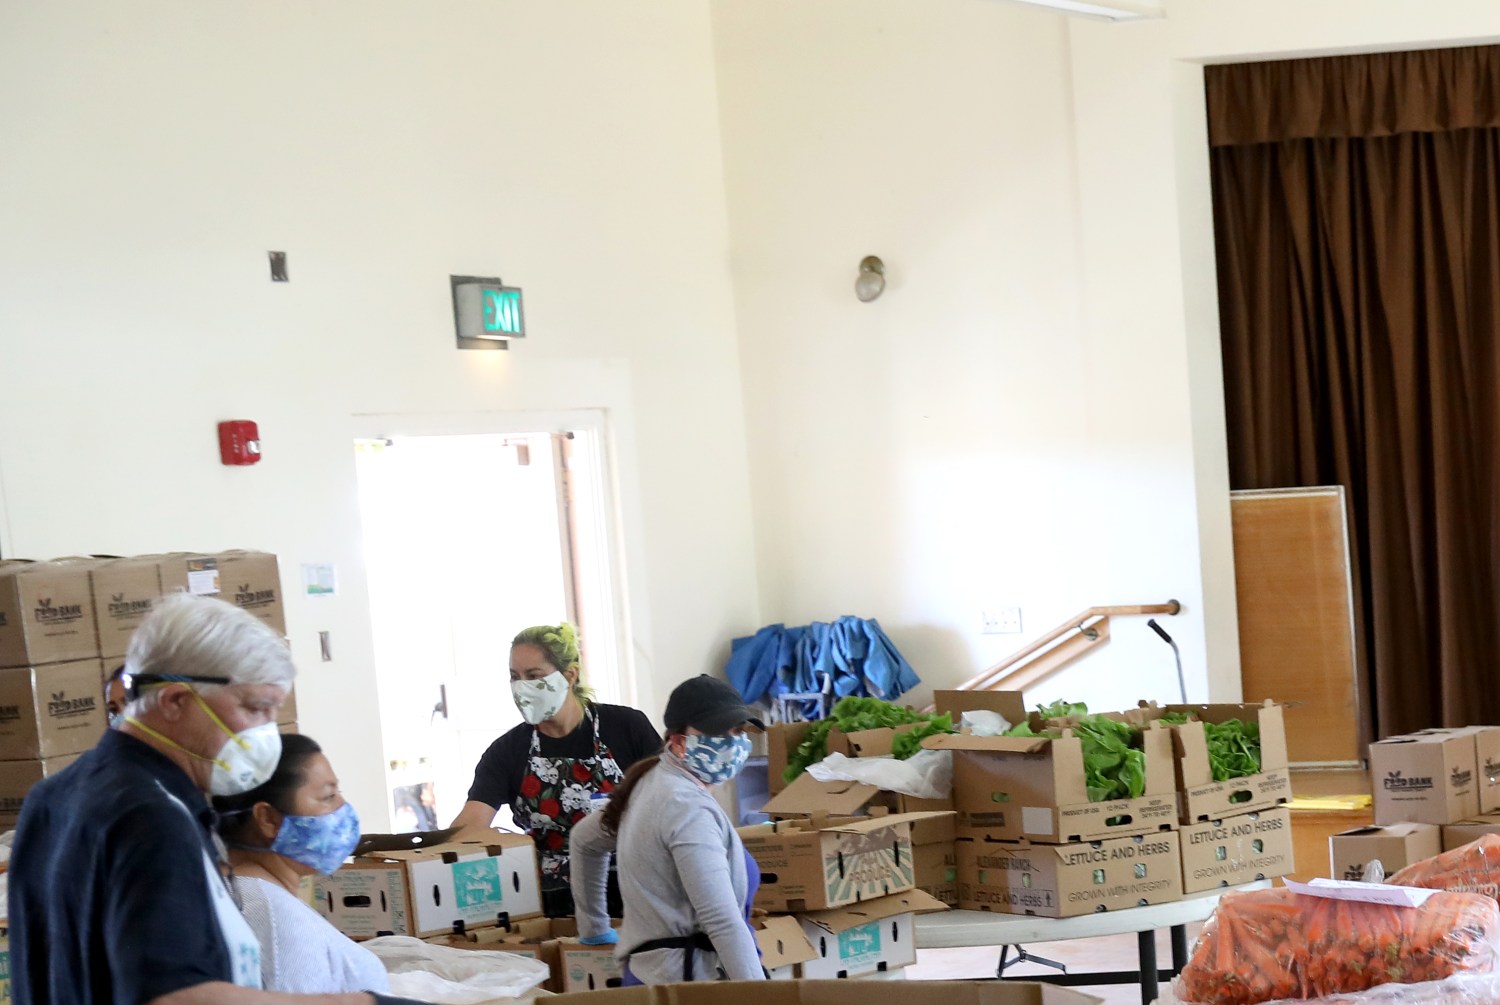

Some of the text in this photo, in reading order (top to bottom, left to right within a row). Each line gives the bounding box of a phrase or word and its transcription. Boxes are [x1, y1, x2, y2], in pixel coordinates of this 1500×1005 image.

[482, 289, 520, 333] EXIT
[1409, 777, 1433, 786] BANK
[1190, 819, 1283, 844] LETTUCE AND HERBS
[1064, 841, 1170, 866] LETTUCE AND HERBS
[1193, 865, 1227, 880] GROWN
[1248, 854, 1284, 868] INTEGRITY
[1020, 895, 1043, 906] HERBS
[1068, 879, 1171, 902] GROWN WITH INTEGRITY
